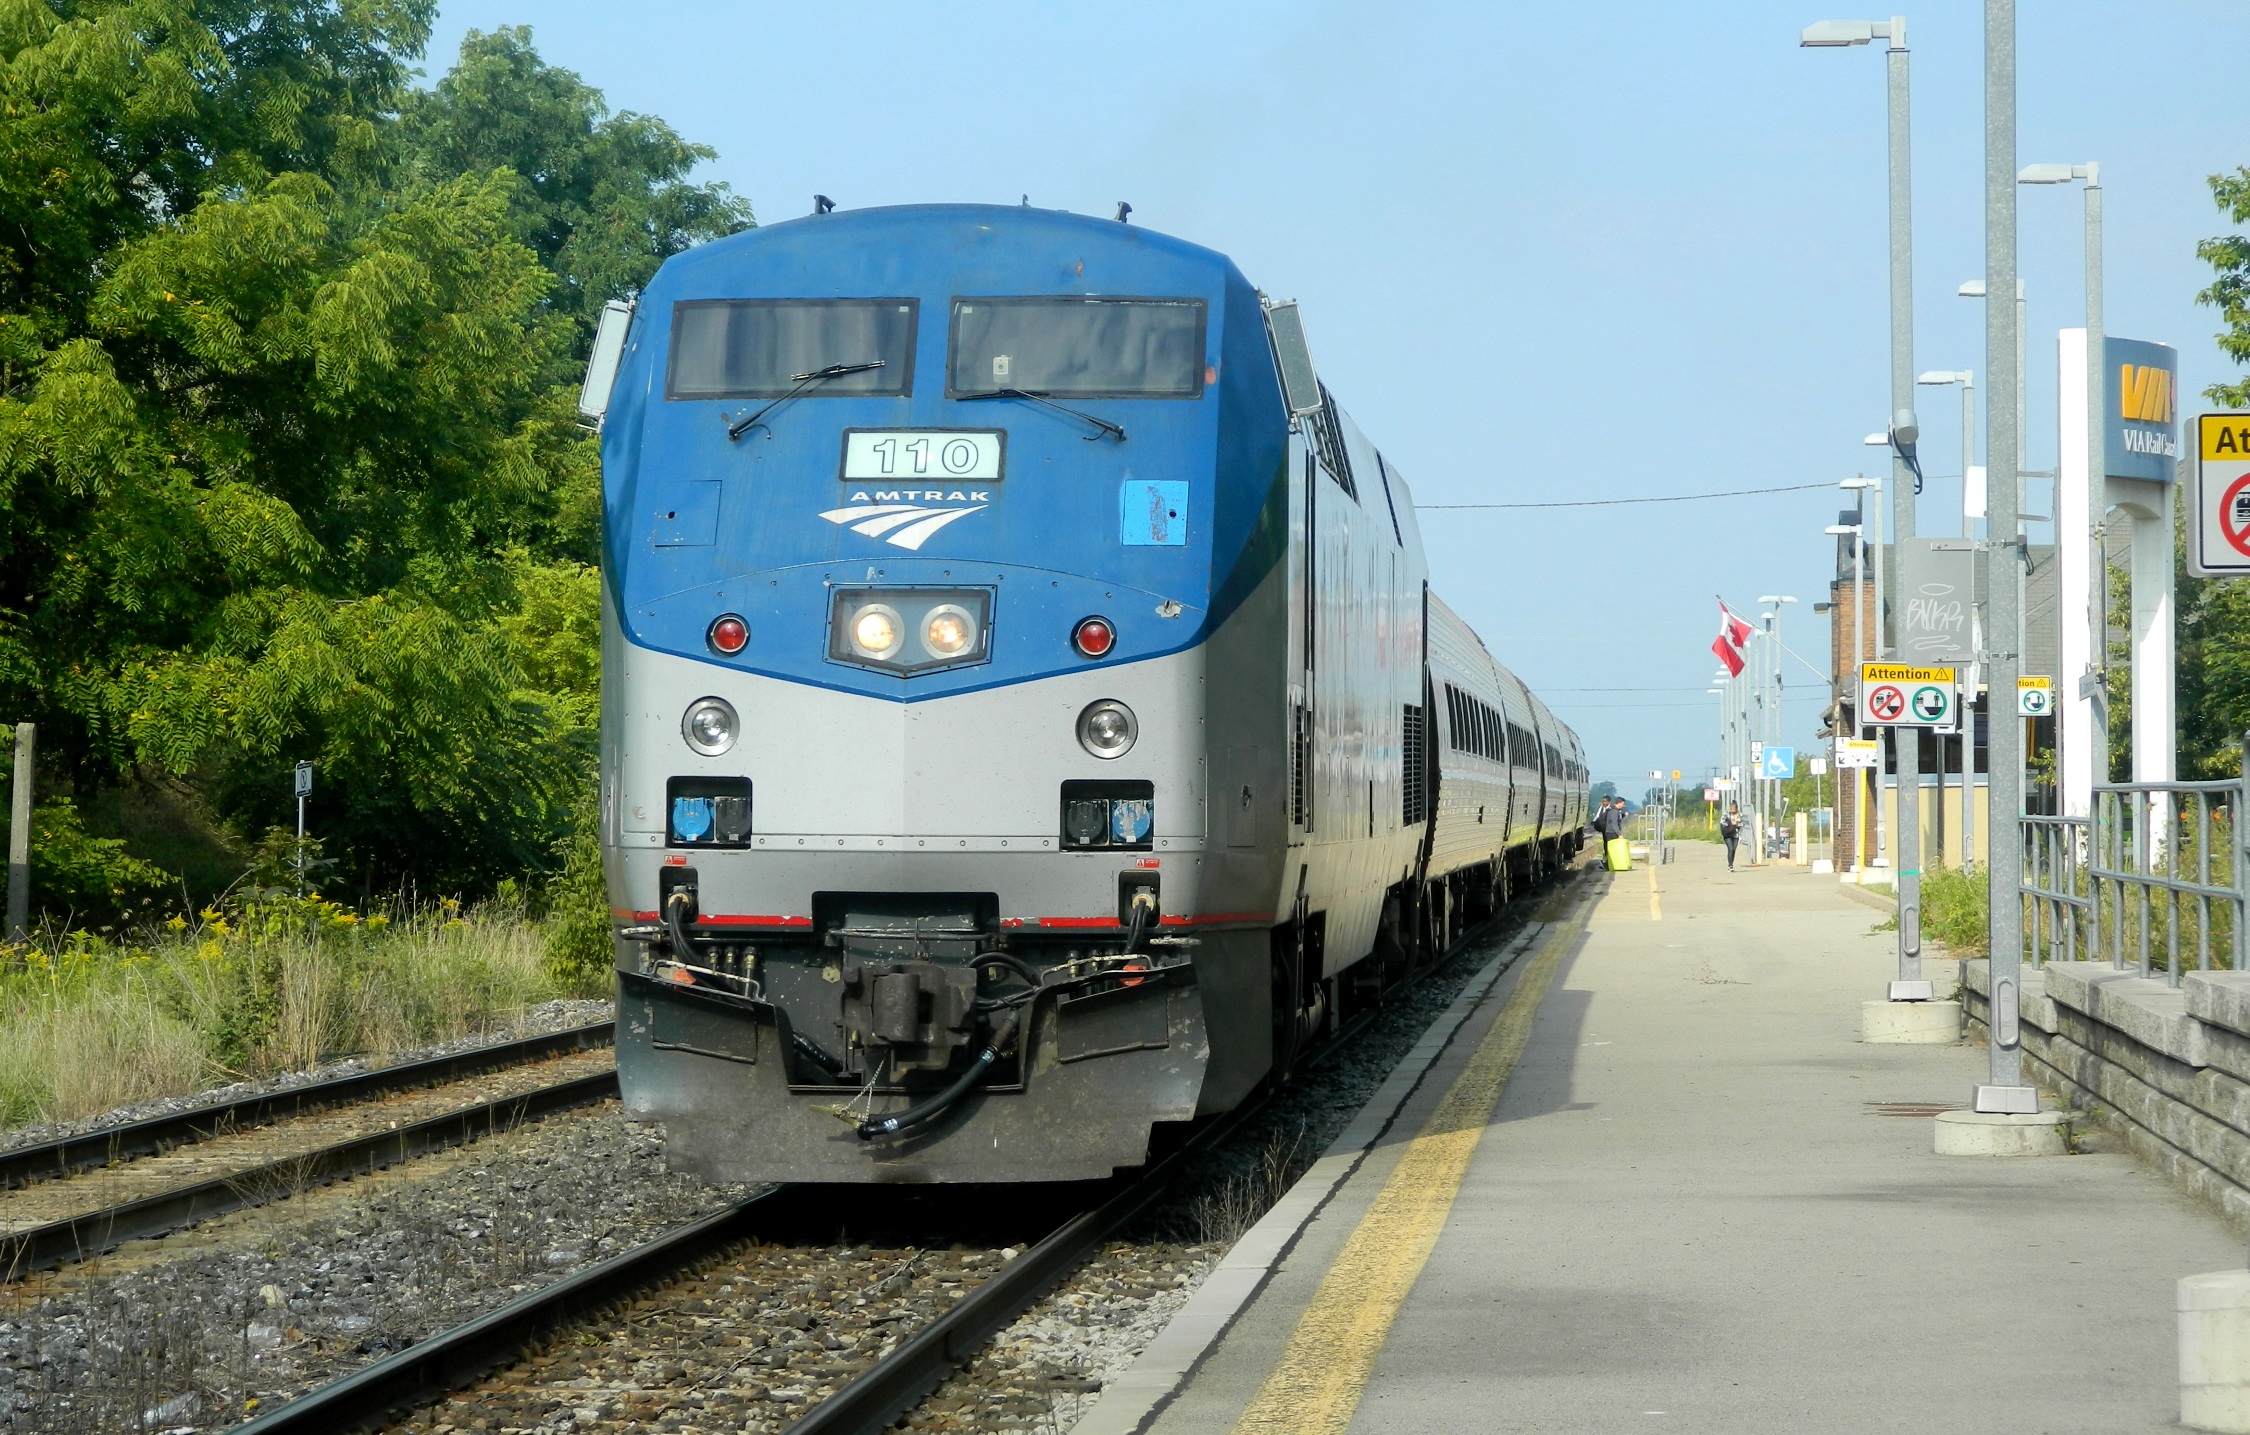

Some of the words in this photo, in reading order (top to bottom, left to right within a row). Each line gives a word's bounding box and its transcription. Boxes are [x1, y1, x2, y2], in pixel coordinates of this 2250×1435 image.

[2122, 364, 2171, 423] VIA
[2123, 429, 2145, 453] VIA
[2145, 431, 2161, 455] Rail
[873, 438, 979, 474] 110
[850, 490, 989, 502] AMTRAK
[1868, 667, 1931, 680] Attention
